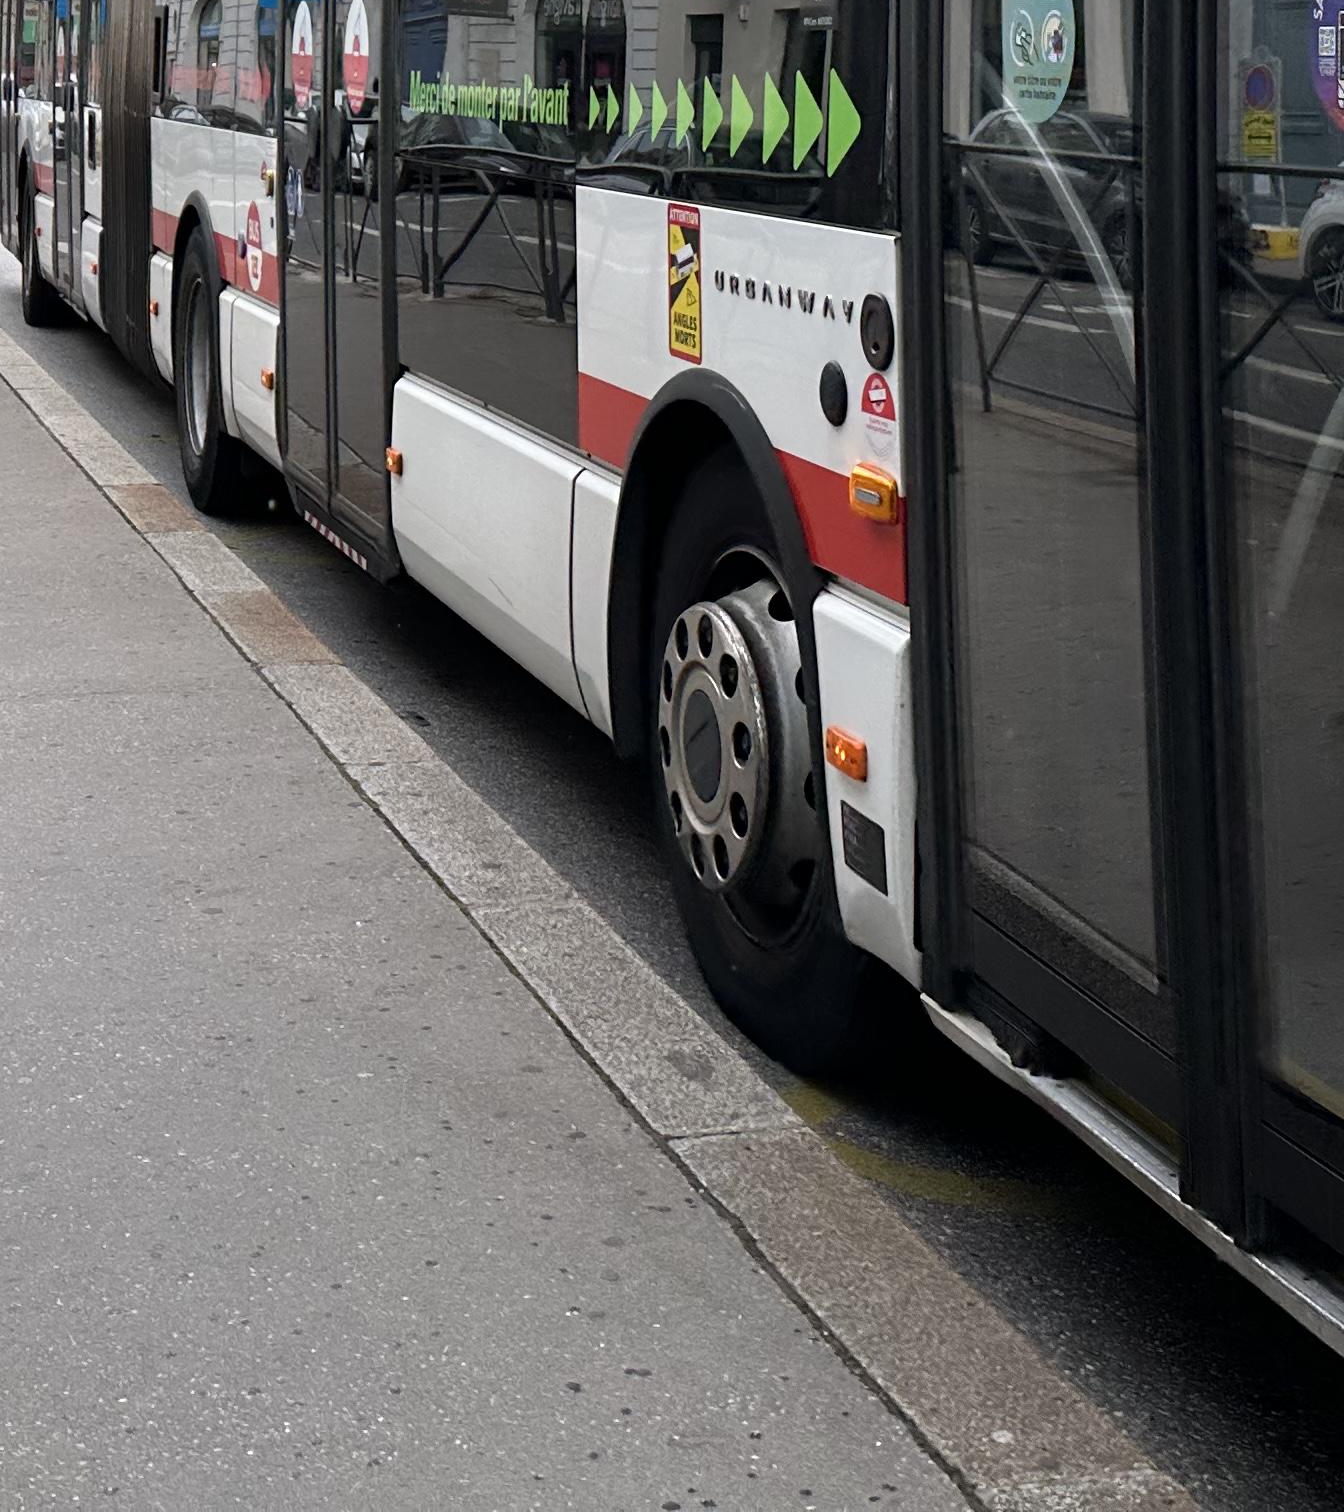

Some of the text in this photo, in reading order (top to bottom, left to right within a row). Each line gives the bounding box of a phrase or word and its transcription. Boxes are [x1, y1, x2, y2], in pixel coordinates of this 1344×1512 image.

[409, 70, 569, 134] Merci de monter par l'avant
[248, 218, 260, 244] BUS
[714, 269, 854, 324] URBANWAY
[672, 311, 698, 332] ANGLES
[674, 328, 697, 349] MORTS
